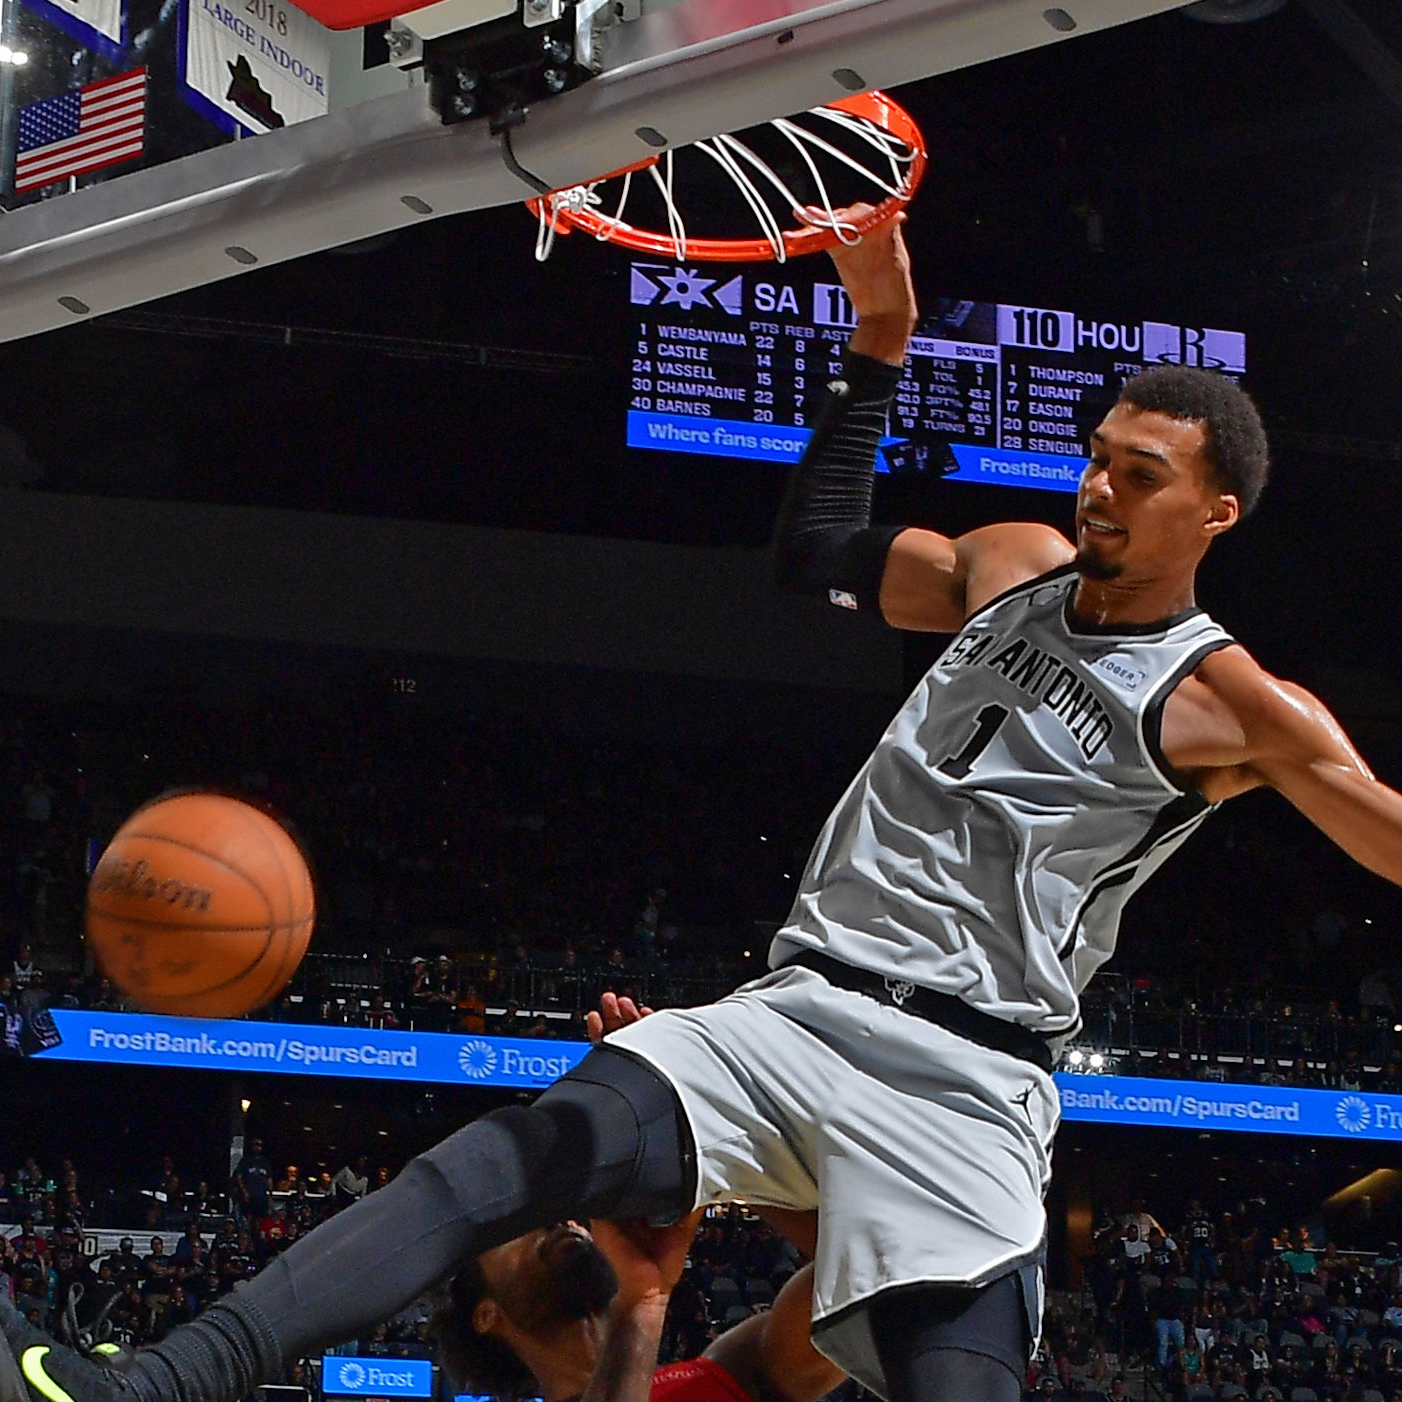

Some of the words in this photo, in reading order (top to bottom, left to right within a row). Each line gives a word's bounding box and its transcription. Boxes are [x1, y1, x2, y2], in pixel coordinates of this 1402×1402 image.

[203, 0, 255, 46] LARGE
[755, 283, 799, 315] SA
[640, 323, 647, 336] 1
[658, 324, 747, 346] WEMBANYAMA
[755, 336, 775, 349] 22
[830, 344, 840, 357] 4
[750, 321, 780, 335] PTS
[785, 325, 814, 339] REB
[821, 329, 852, 342] AST
[1013, 309, 1060, 348] 110
[1078, 320, 1140, 352] HOU
[638, 342, 648, 354] 5
[657, 343, 709, 361] CASTLE
[756, 354, 772, 367] 14
[909, 341, 935, 353] NUS
[632, 360, 652, 373] 24
[657, 361, 716, 380] VASSELL
[756, 373, 772, 386] 15
[794, 377, 805, 390] 3
[1010, 364, 1016, 376] 1
[1029, 365, 1104, 387] THOMPSON
[631, 378, 652, 392] 30
[657, 380, 746, 402] CHAMPAGNIE
[754, 391, 774, 405] 22
[794, 396, 804, 408] 7
[1008, 382, 1017, 394] 7
[1029, 384, 1083, 401] DURANT
[631, 397, 652, 410] 40
[656, 398, 711, 416] BARNES
[753, 409, 773, 423] 20
[794, 414, 804, 426] 5
[1006, 400, 1019, 412] 17
[1029, 402, 1073, 418] EASON
[648, 423, 710, 444] Where
[713, 427, 758, 449] fans
[760, 433, 808, 452] scor
[1003, 418, 1022, 431] 20
[1029, 421, 1078, 437] OKOGIE
[1004, 436, 1022, 449] 28
[1029, 438, 1083, 456] SENGUN
[979, 456, 1082, 483] FrostBank.
[1099, 658, 1136, 682] EDGER
[936, 703, 1009, 780] 1
[89, 1027, 417, 1068] FrostBank.com/SpursCard
[501, 1049, 571, 1078] Frost
[369, 1368, 415, 1388] Frost
